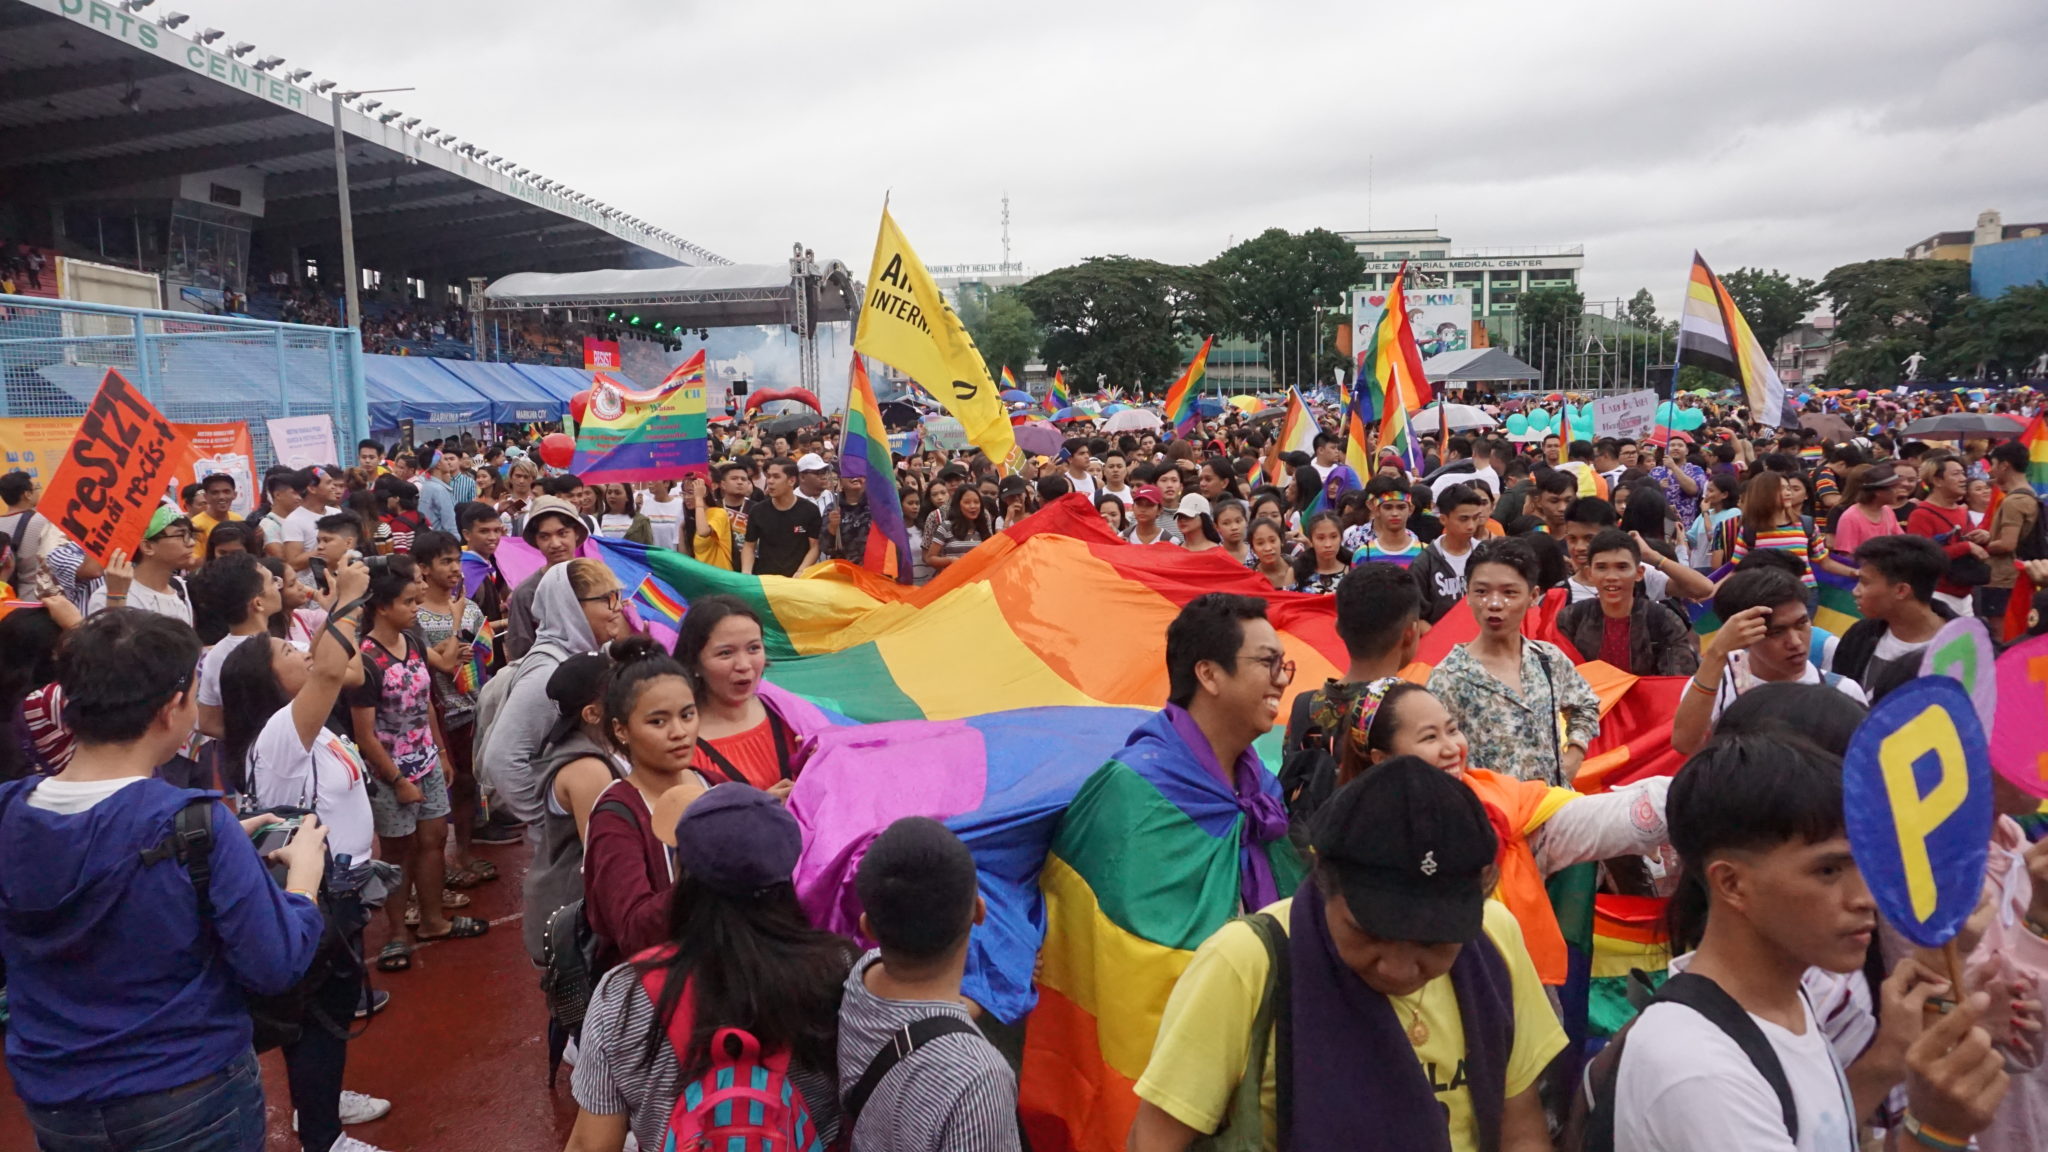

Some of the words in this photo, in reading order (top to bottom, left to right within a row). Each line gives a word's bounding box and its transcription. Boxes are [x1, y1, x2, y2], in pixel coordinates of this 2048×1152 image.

[187, 46, 302, 109] CENTER
[957, 262, 970, 272] CITY
[973, 261, 996, 272] HEALTH
[1449, 260, 1494, 269] MEDICAL
[1498, 259, 1543, 268] CENTER
[870, 288, 933, 338] INTERN
[85, 496, 125, 558] hindi
[1878, 703, 1970, 924] P
